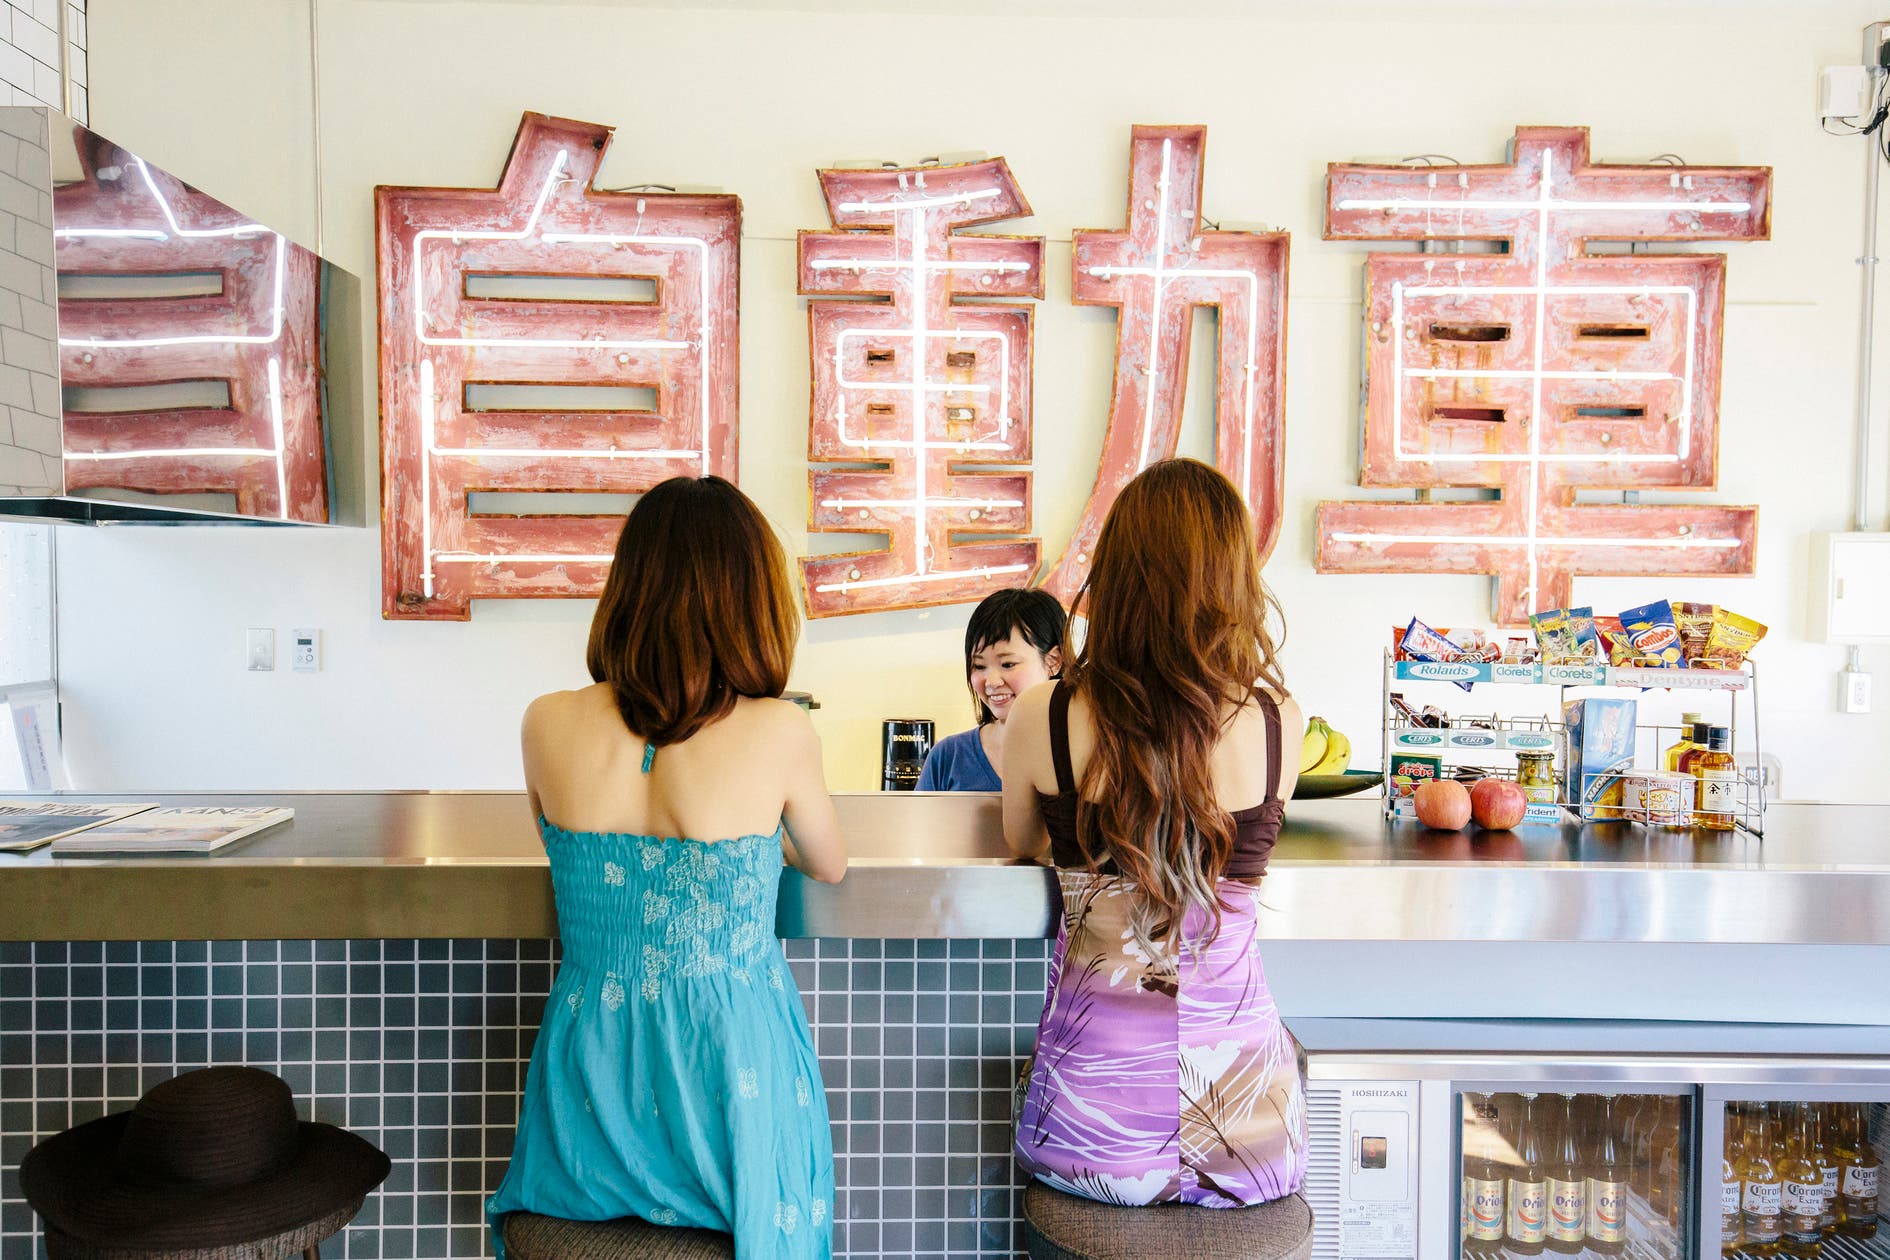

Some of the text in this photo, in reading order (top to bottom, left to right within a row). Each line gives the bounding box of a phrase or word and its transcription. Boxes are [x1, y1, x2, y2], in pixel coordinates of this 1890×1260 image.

[1635, 627, 1674, 649] Combos
[1420, 663, 1469, 676] Rolaids
[1496, 667, 1532, 677] Clorets
[1549, 667, 1593, 679] Clorets
[1640, 673, 1721, 688] Dentyne
[1398, 765, 1435, 777] drops
[1708, 782, 1731, 796] 余市
[1527, 807, 1557, 816] rident
